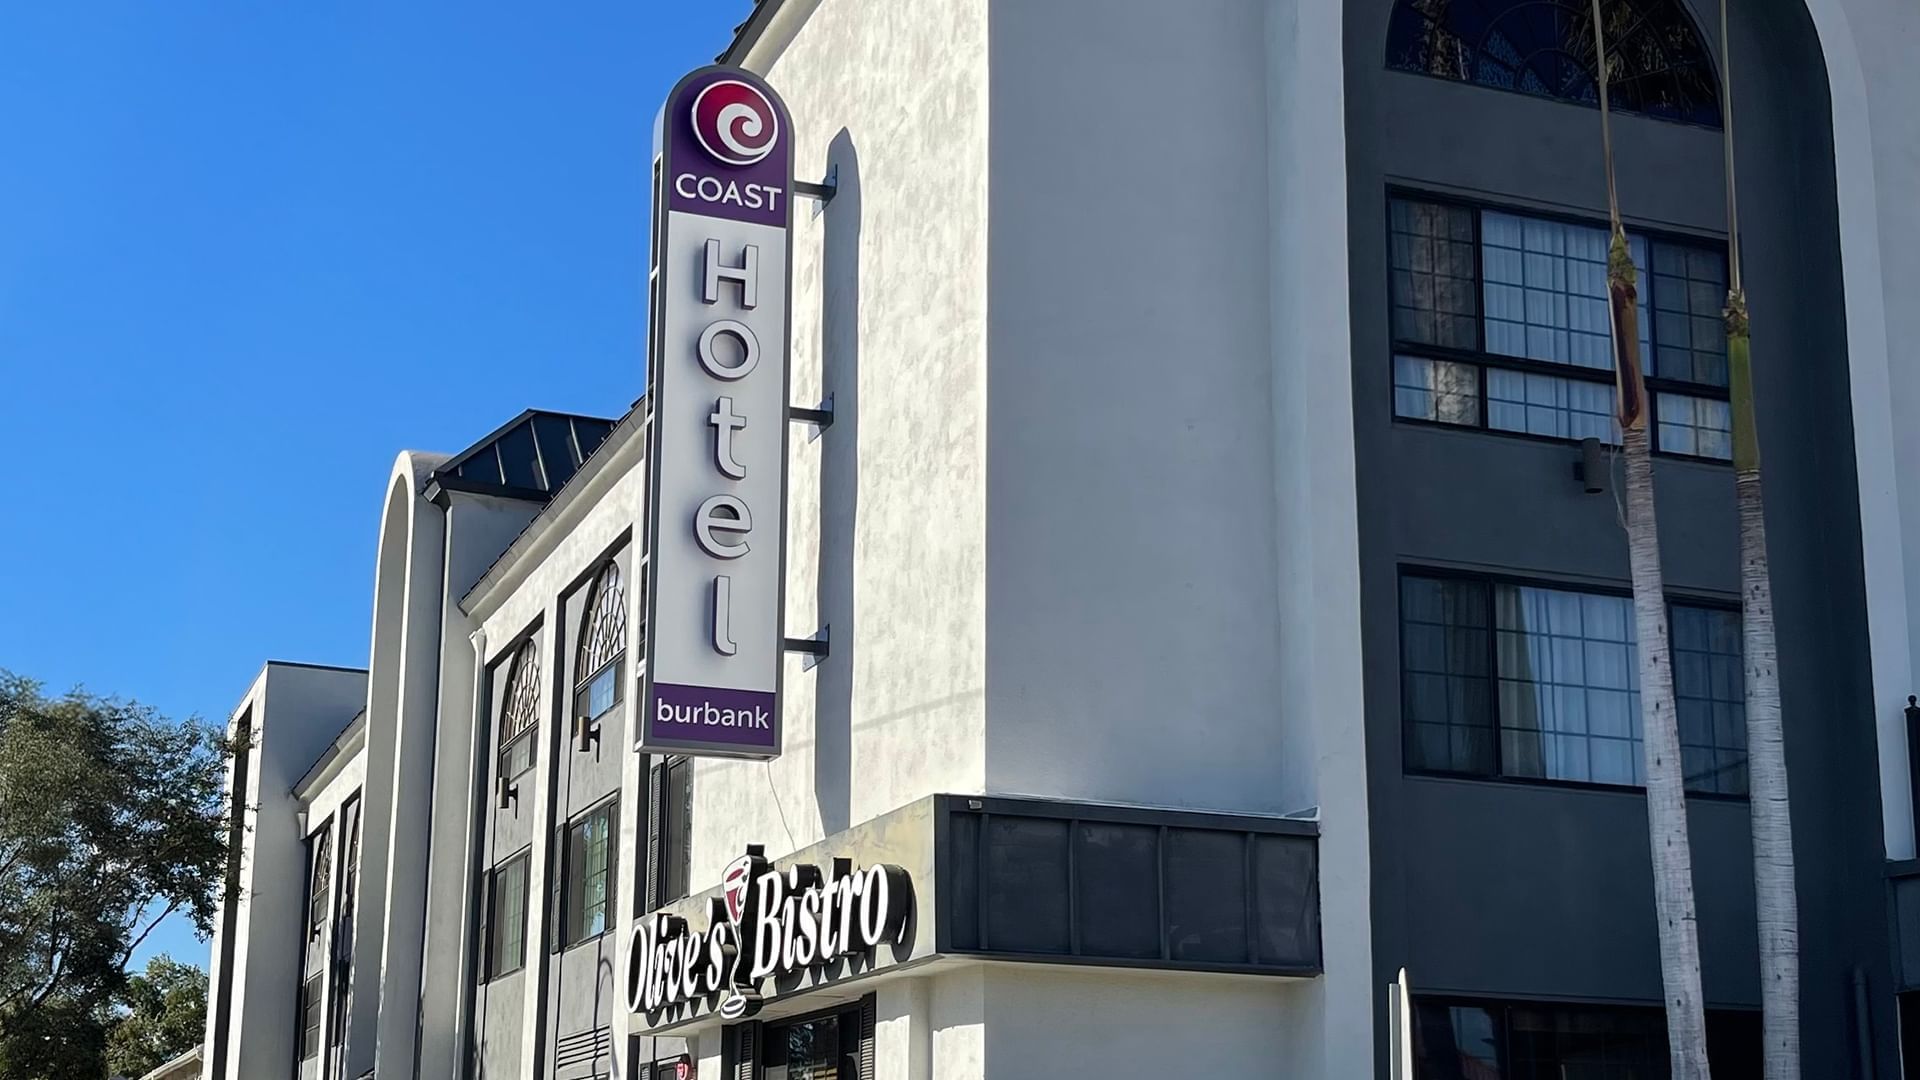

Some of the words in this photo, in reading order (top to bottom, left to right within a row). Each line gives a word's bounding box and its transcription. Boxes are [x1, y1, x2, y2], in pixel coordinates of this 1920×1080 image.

[675, 173, 782, 211] COAST
[695, 238, 761, 657] Hotel
[656, 698, 769, 730] burbank
[624, 896, 726, 1014] Olive's
[750, 862, 890, 986] Bistro
